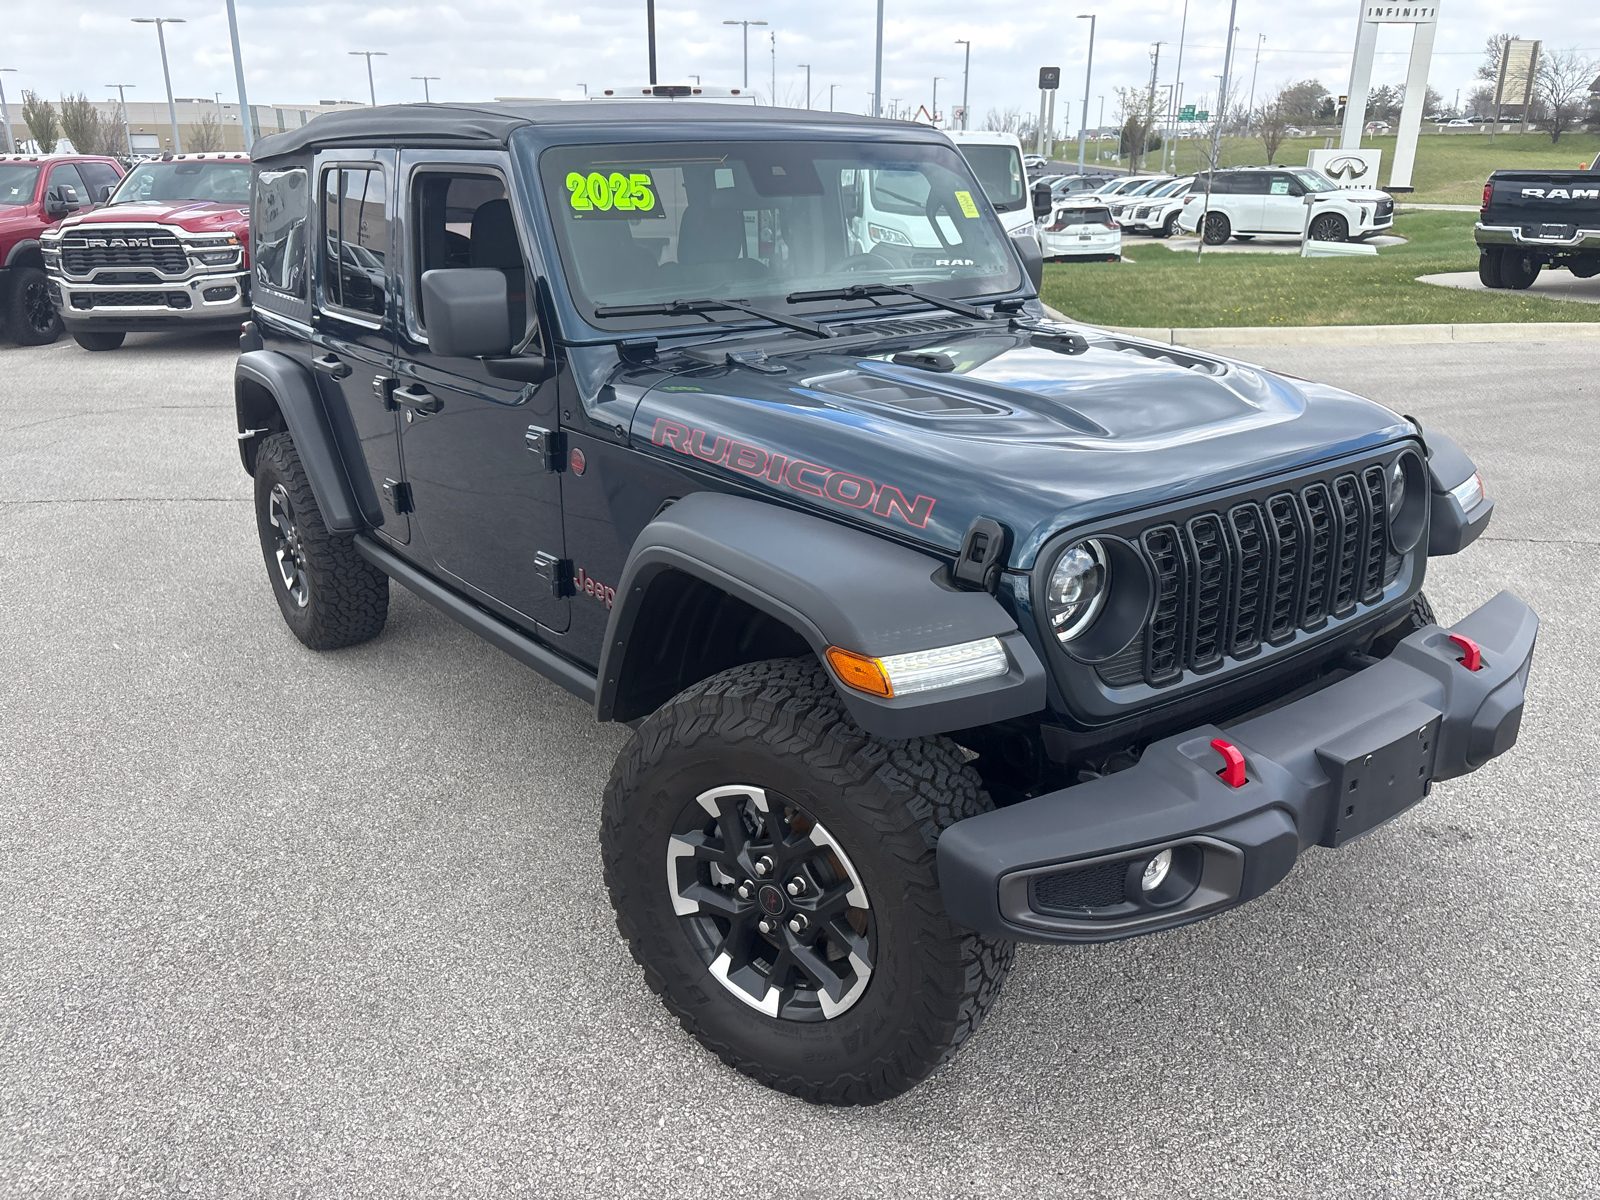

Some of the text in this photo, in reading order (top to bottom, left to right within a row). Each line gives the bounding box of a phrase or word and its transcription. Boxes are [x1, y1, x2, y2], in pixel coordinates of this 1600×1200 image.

[1368, 7, 1435, 17] INFINITI
[565, 171, 656, 212] 2025
[1521, 188, 1600, 200] RAM
[88, 238, 149, 248] RAM
[651, 417, 937, 529] RUBICON
[573, 567, 617, 610] Jeep
